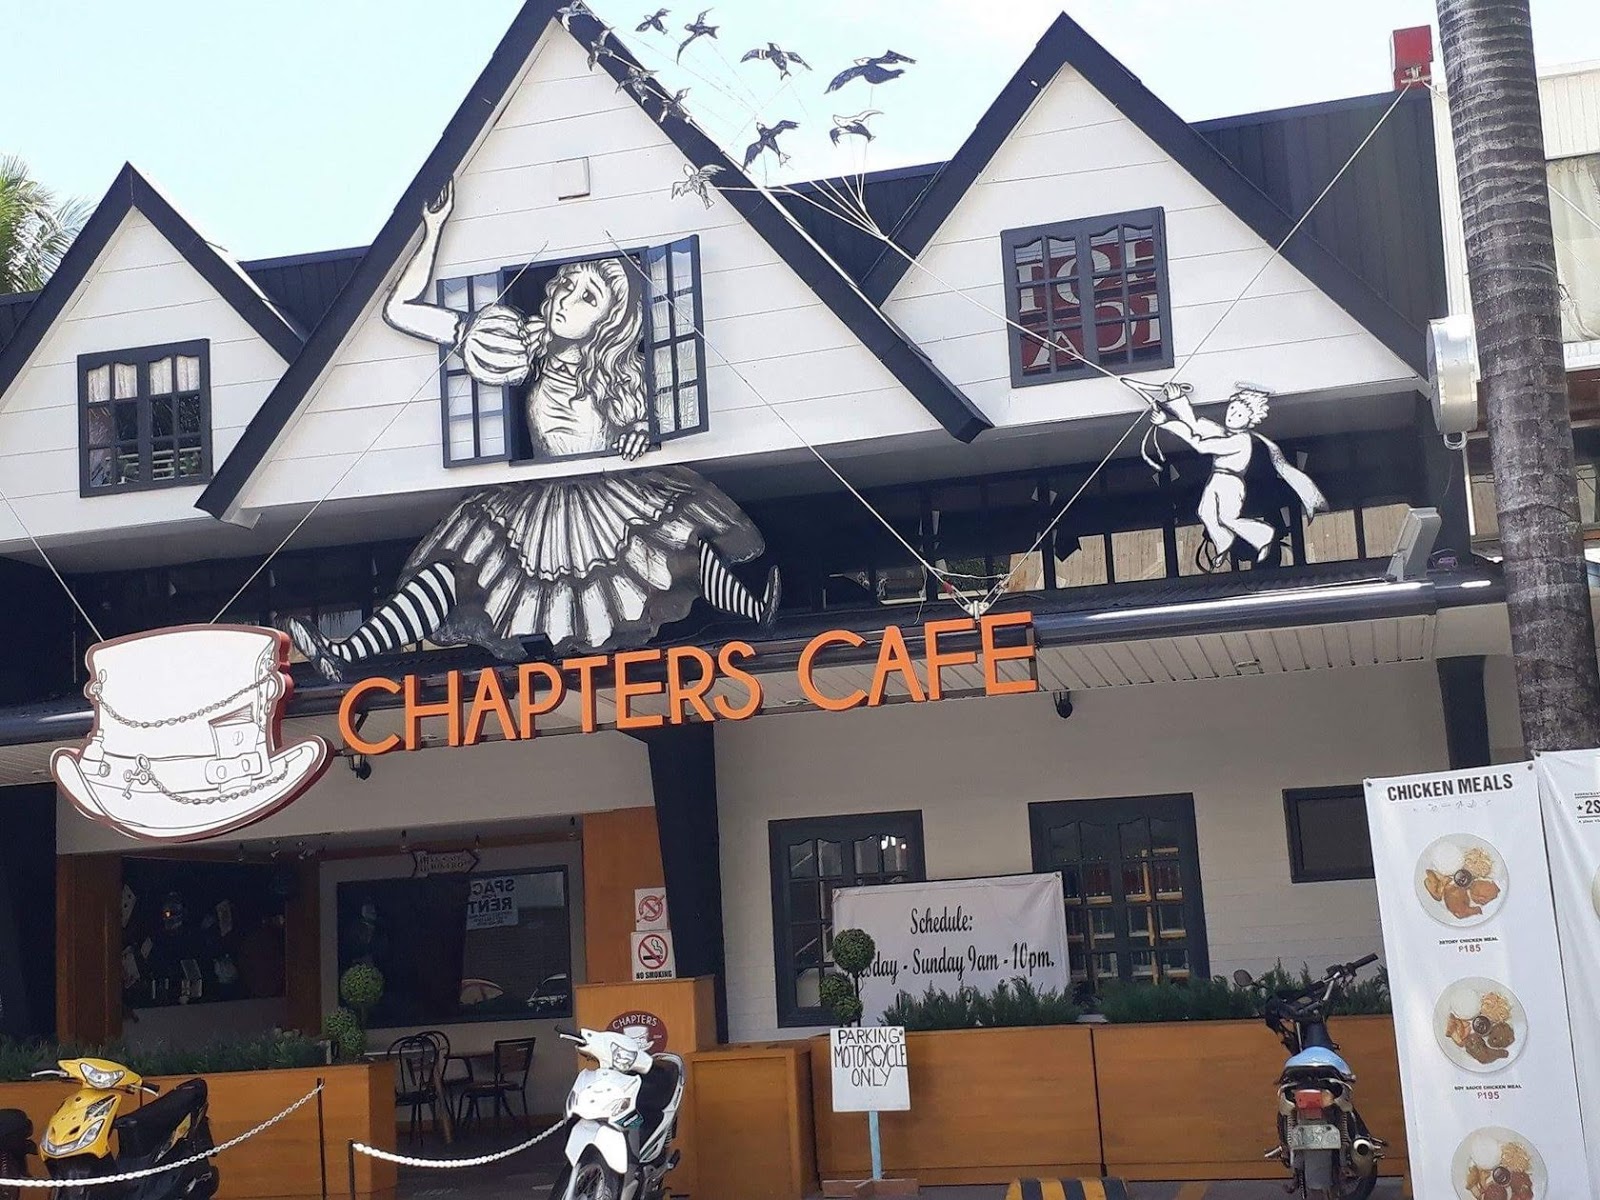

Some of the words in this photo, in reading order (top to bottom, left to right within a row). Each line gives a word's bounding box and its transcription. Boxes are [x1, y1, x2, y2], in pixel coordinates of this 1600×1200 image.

[338, 641, 763, 755] CHAPTERS
[797, 611, 1037, 712] CAFE
[1387, 779, 1454, 801] CHICKEN
[1458, 774, 1513, 794] MEALS
[910, 905, 973, 935] Schedule:
[912, 947, 965, 981] Sunday
[968, 945, 998, 972] 9am
[1012, 942, 1055, 977] 10pm.
[636, 971, 645, 979] NO
[645, 970, 672, 979] SMOKING
[612, 1014, 658, 1029] CHAPTERS
[837, 1029, 900, 1045] PARKING
[834, 1044, 907, 1068] MOTORCYCLE
[851, 1067, 892, 1086] ONLY
